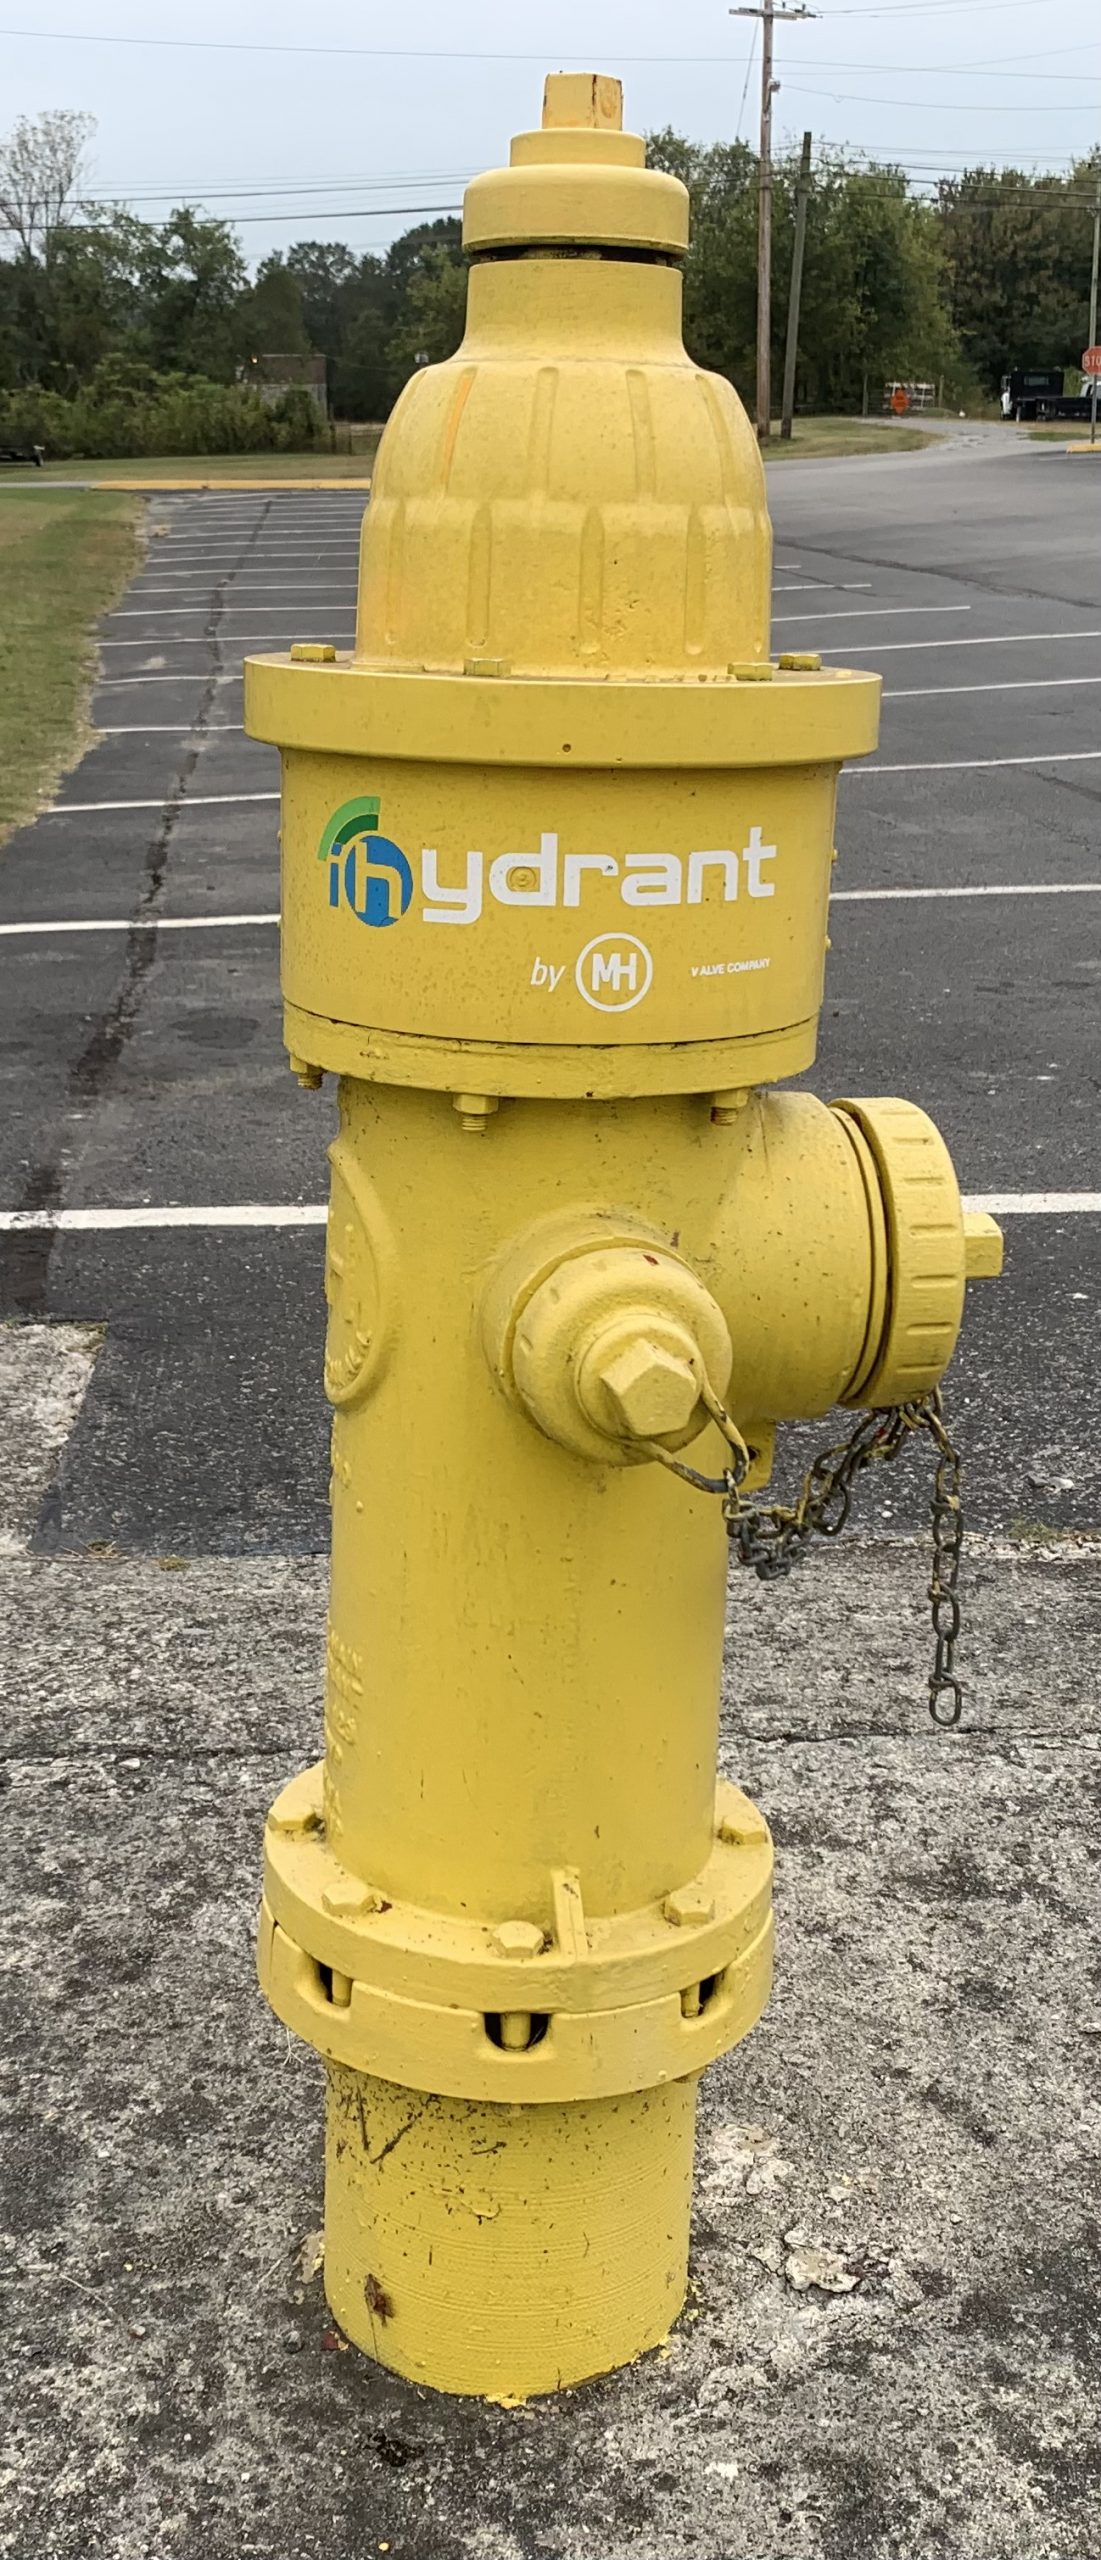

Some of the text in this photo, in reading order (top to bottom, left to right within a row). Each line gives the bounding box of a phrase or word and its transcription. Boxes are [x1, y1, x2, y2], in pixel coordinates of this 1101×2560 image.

[1085, 355, 1101, 367] STO
[530, 956, 566, 993] by
[591, 952, 638, 991] MH
[727, 957, 771, 973] COMPANY
